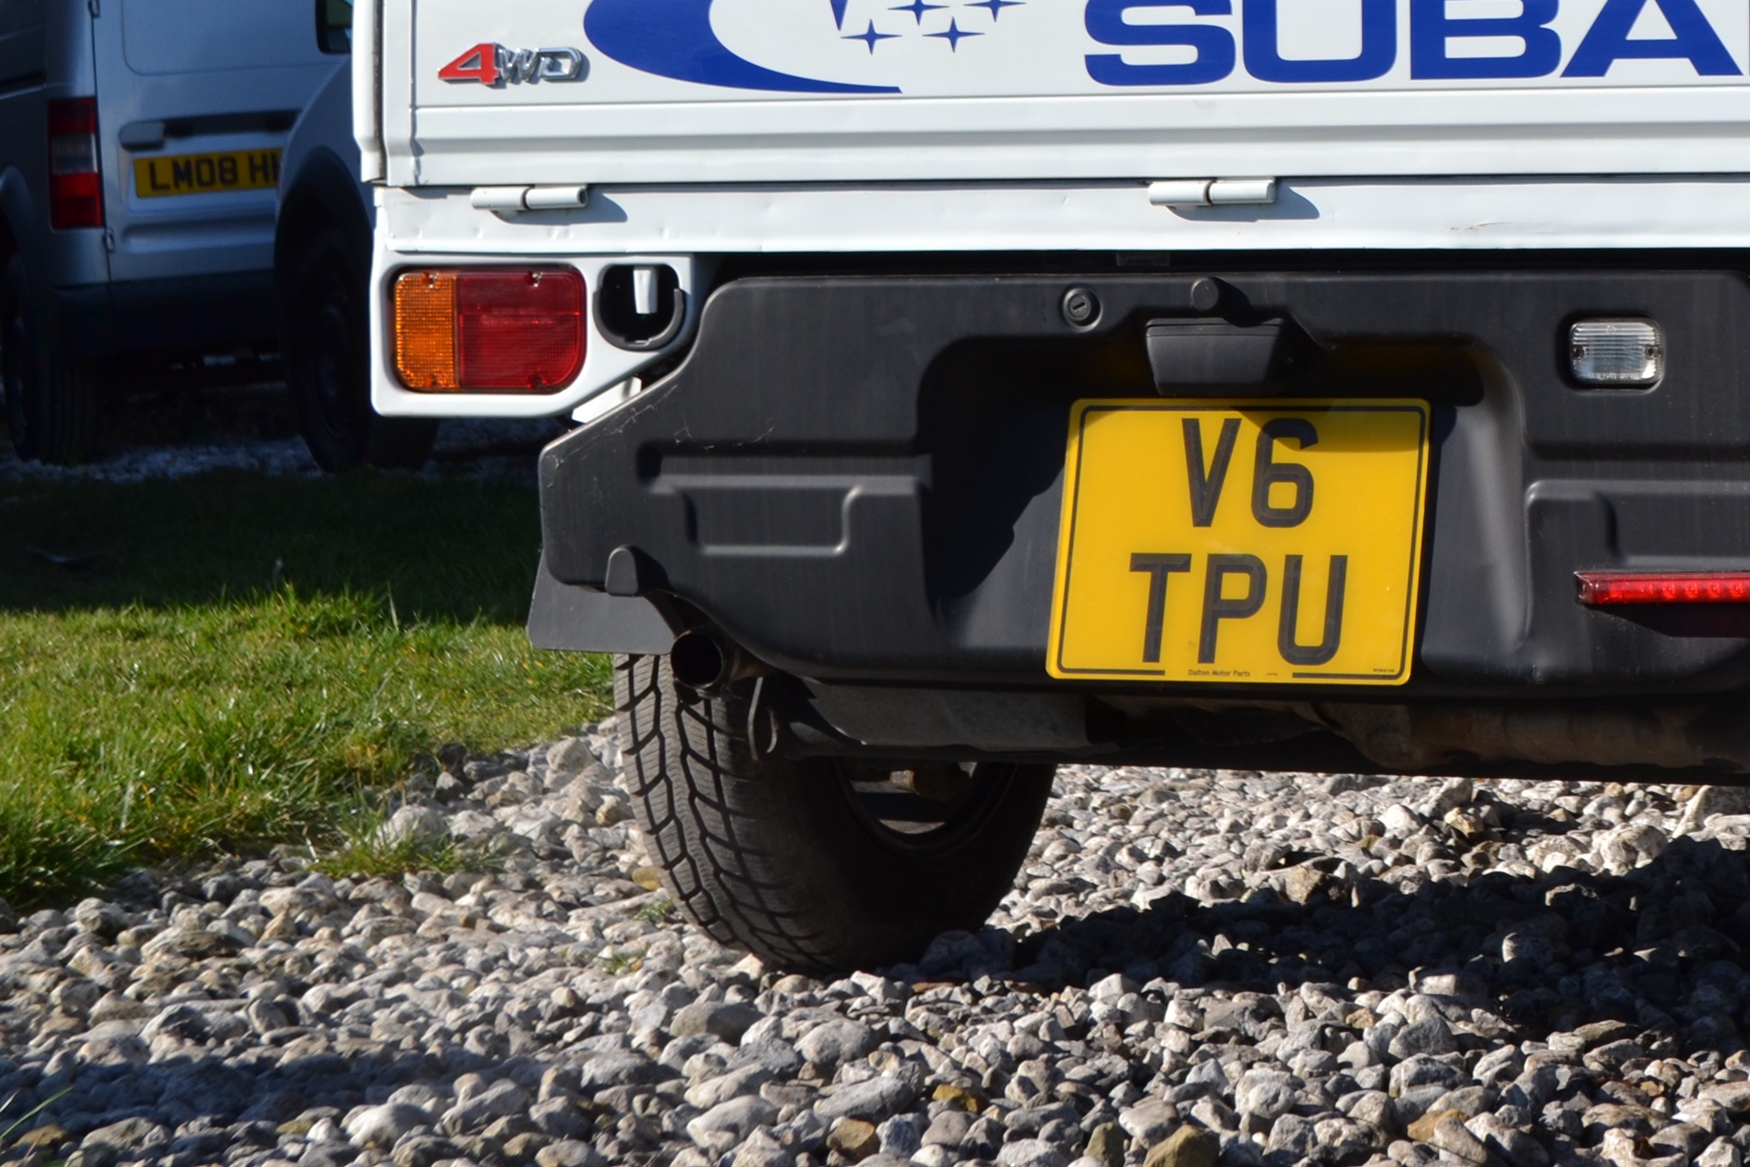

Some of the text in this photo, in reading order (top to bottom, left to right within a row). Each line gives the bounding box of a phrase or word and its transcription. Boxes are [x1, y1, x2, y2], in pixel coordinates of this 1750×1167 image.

[437, 42, 587, 88] 4WD
[149, 155, 239, 192] LM08
[1181, 418, 1319, 529] V6
[1129, 552, 1349, 666] TPU
[1212, 669, 1231, 677] Motor
[1233, 670, 1250, 678] Parts
